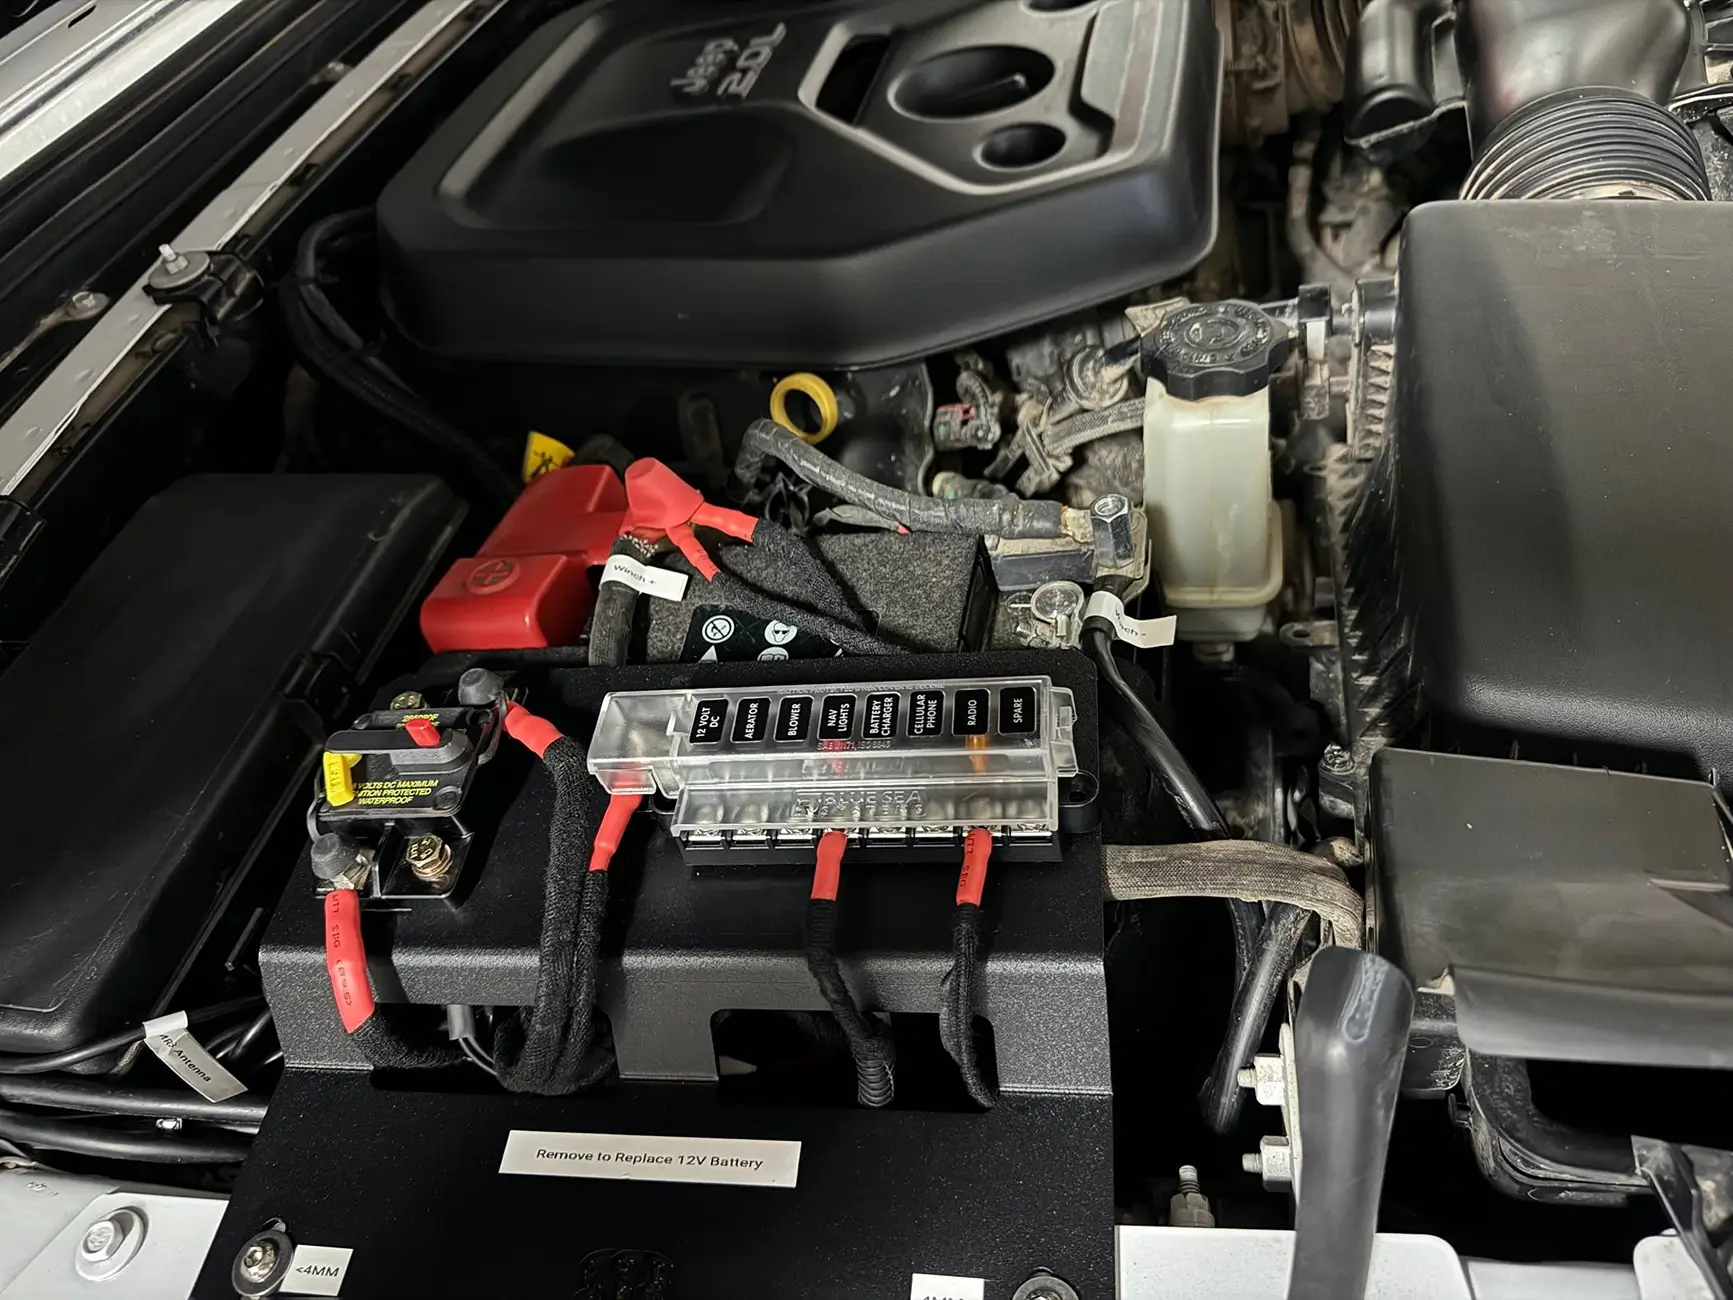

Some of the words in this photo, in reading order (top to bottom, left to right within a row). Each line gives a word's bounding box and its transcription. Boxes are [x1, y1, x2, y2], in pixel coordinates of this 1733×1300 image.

[613, 563, 646, 583] Winch
[698, 706, 711, 727] VOLT
[709, 715, 720, 728] DC
[744, 702, 759, 739] AERATOR
[788, 703, 801, 737] BLOWER
[827, 709, 838, 727] NAV
[838, 703, 850, 732] LIGHTS
[869, 700, 882, 734] BATTERY
[881, 696, 894, 736] CHARGER
[914, 694, 926, 735] CELLULAR
[926, 699, 938, 728] PHONE
[967, 699, 978, 726] RADIO
[1013, 698, 1023, 724] SPARE
[696, 728, 707, 738] 12
[358, 781, 382, 790] VOLTS
[383, 781, 396, 789] DC
[396, 779, 439, 789] MAXIMUM
[382, 788, 432, 797] PROTECTED
[358, 796, 414, 805] WATERPROOF
[881, 790, 924, 804] SEA
[173, 1048, 212, 1083] Antenna
[536, 1148, 594, 1162] Remove
[597, 1150, 612, 1162] to
[614, 1152, 673, 1166] Replace
[677, 1154, 708, 1166] 12V
[709, 1155, 764, 1171] Battery
[295, 1264, 340, 1278] <4MM
